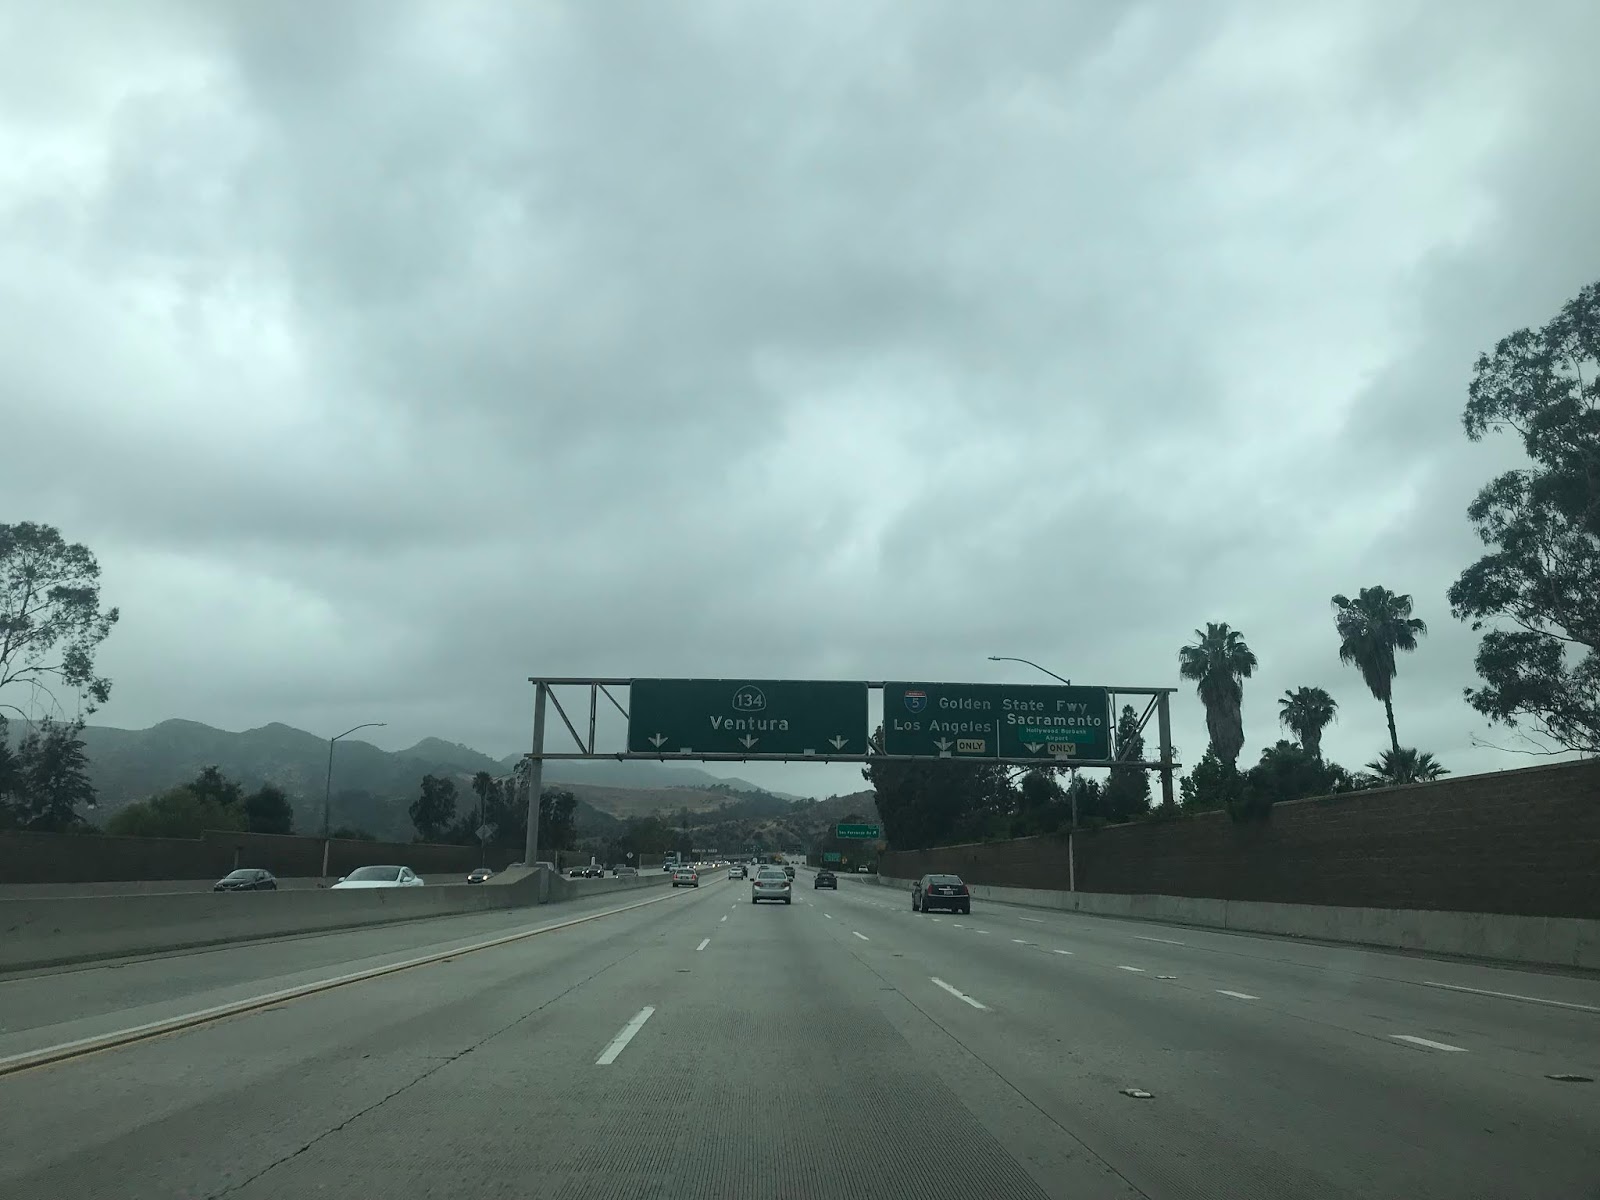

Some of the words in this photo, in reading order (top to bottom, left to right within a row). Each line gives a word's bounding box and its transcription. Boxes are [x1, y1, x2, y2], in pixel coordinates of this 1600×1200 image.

[737, 694, 763, 707] 134
[912, 697, 920, 708] 5
[939, 697, 991, 710] Golden
[1002, 698, 1044, 711] State
[1056, 700, 1088, 715] Fwy
[710, 715, 789, 731] Ventura
[1006, 712, 1102, 727] Sacramento
[893, 718, 921, 731] Los
[928, 719, 992, 735] Angeles
[1045, 735, 1069, 743] Airport
[958, 742, 983, 750] ONLY
[1049, 744, 1074, 753] ONLY
